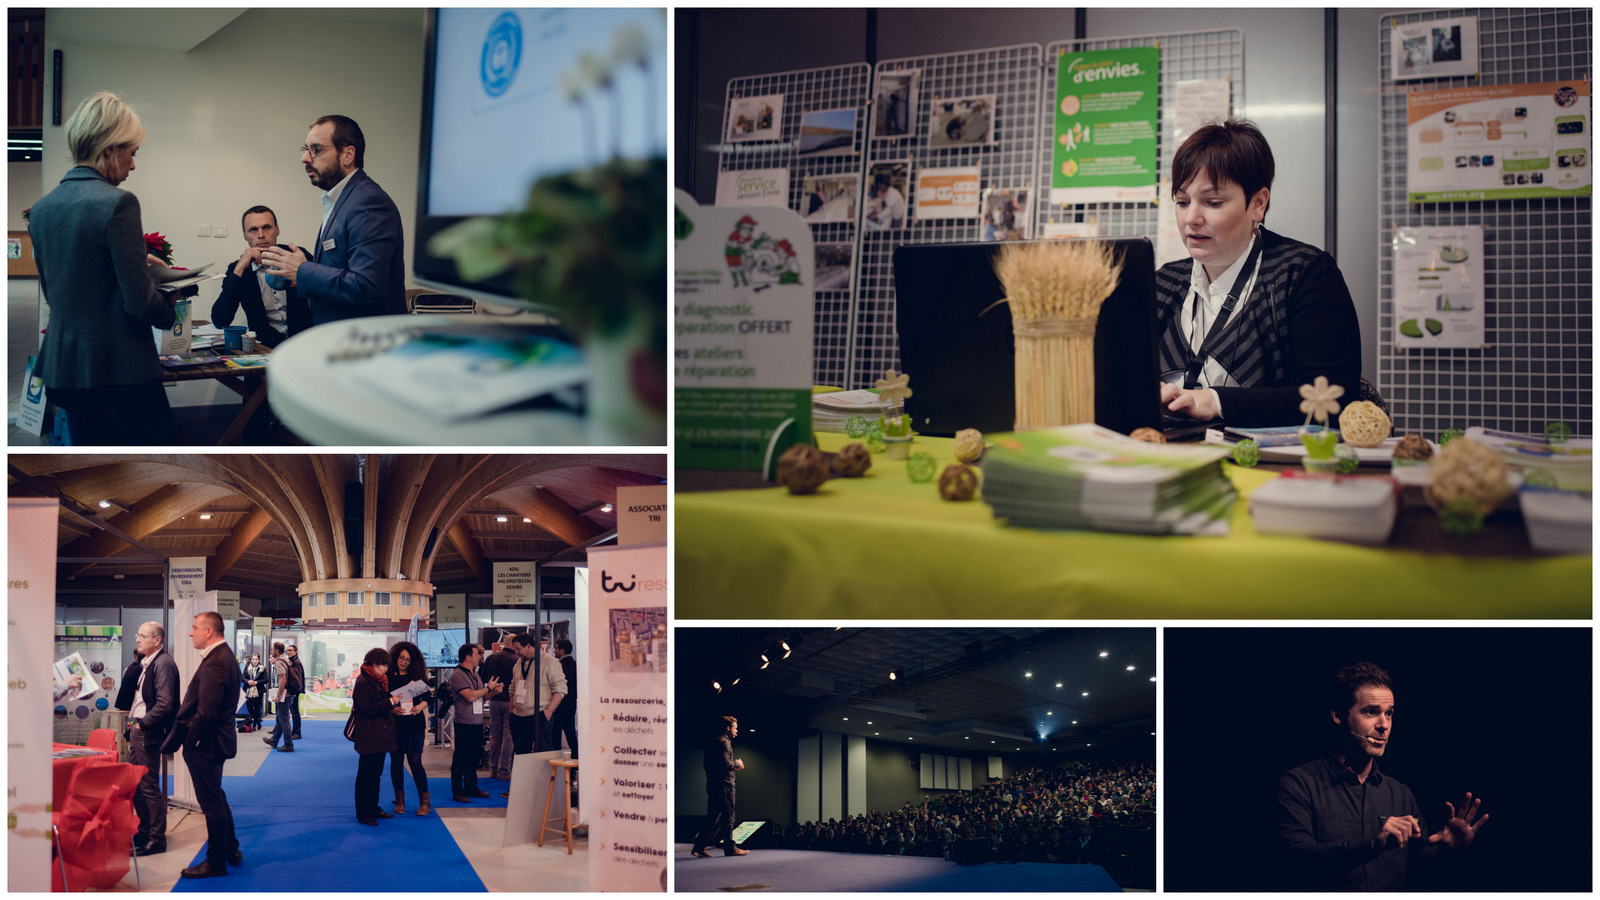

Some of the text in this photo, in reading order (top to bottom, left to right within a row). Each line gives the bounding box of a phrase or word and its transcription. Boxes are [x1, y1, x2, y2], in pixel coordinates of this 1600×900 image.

[737, 178, 777, 193] service
[737, 190, 780, 200] version Envie
[683, 302, 753, 319] diagnostic
[738, 320, 792, 334] OFFERT
[693, 346, 744, 360] ateliers
[684, 363, 756, 381] réparation
[602, 570, 636, 593] tri
[612, 698, 666, 706] ressourcerie,
[613, 712, 651, 725] Réduire,
[625, 726, 654, 735] déchets
[613, 746, 657, 756] Collecter
[613, 778, 655, 789] Valoriser
[622, 792, 654, 801] nettoyer
[613, 810, 646, 822] Vendre
[613, 843, 667, 857] Sensibiliser
[628, 858, 659, 868] déchets
